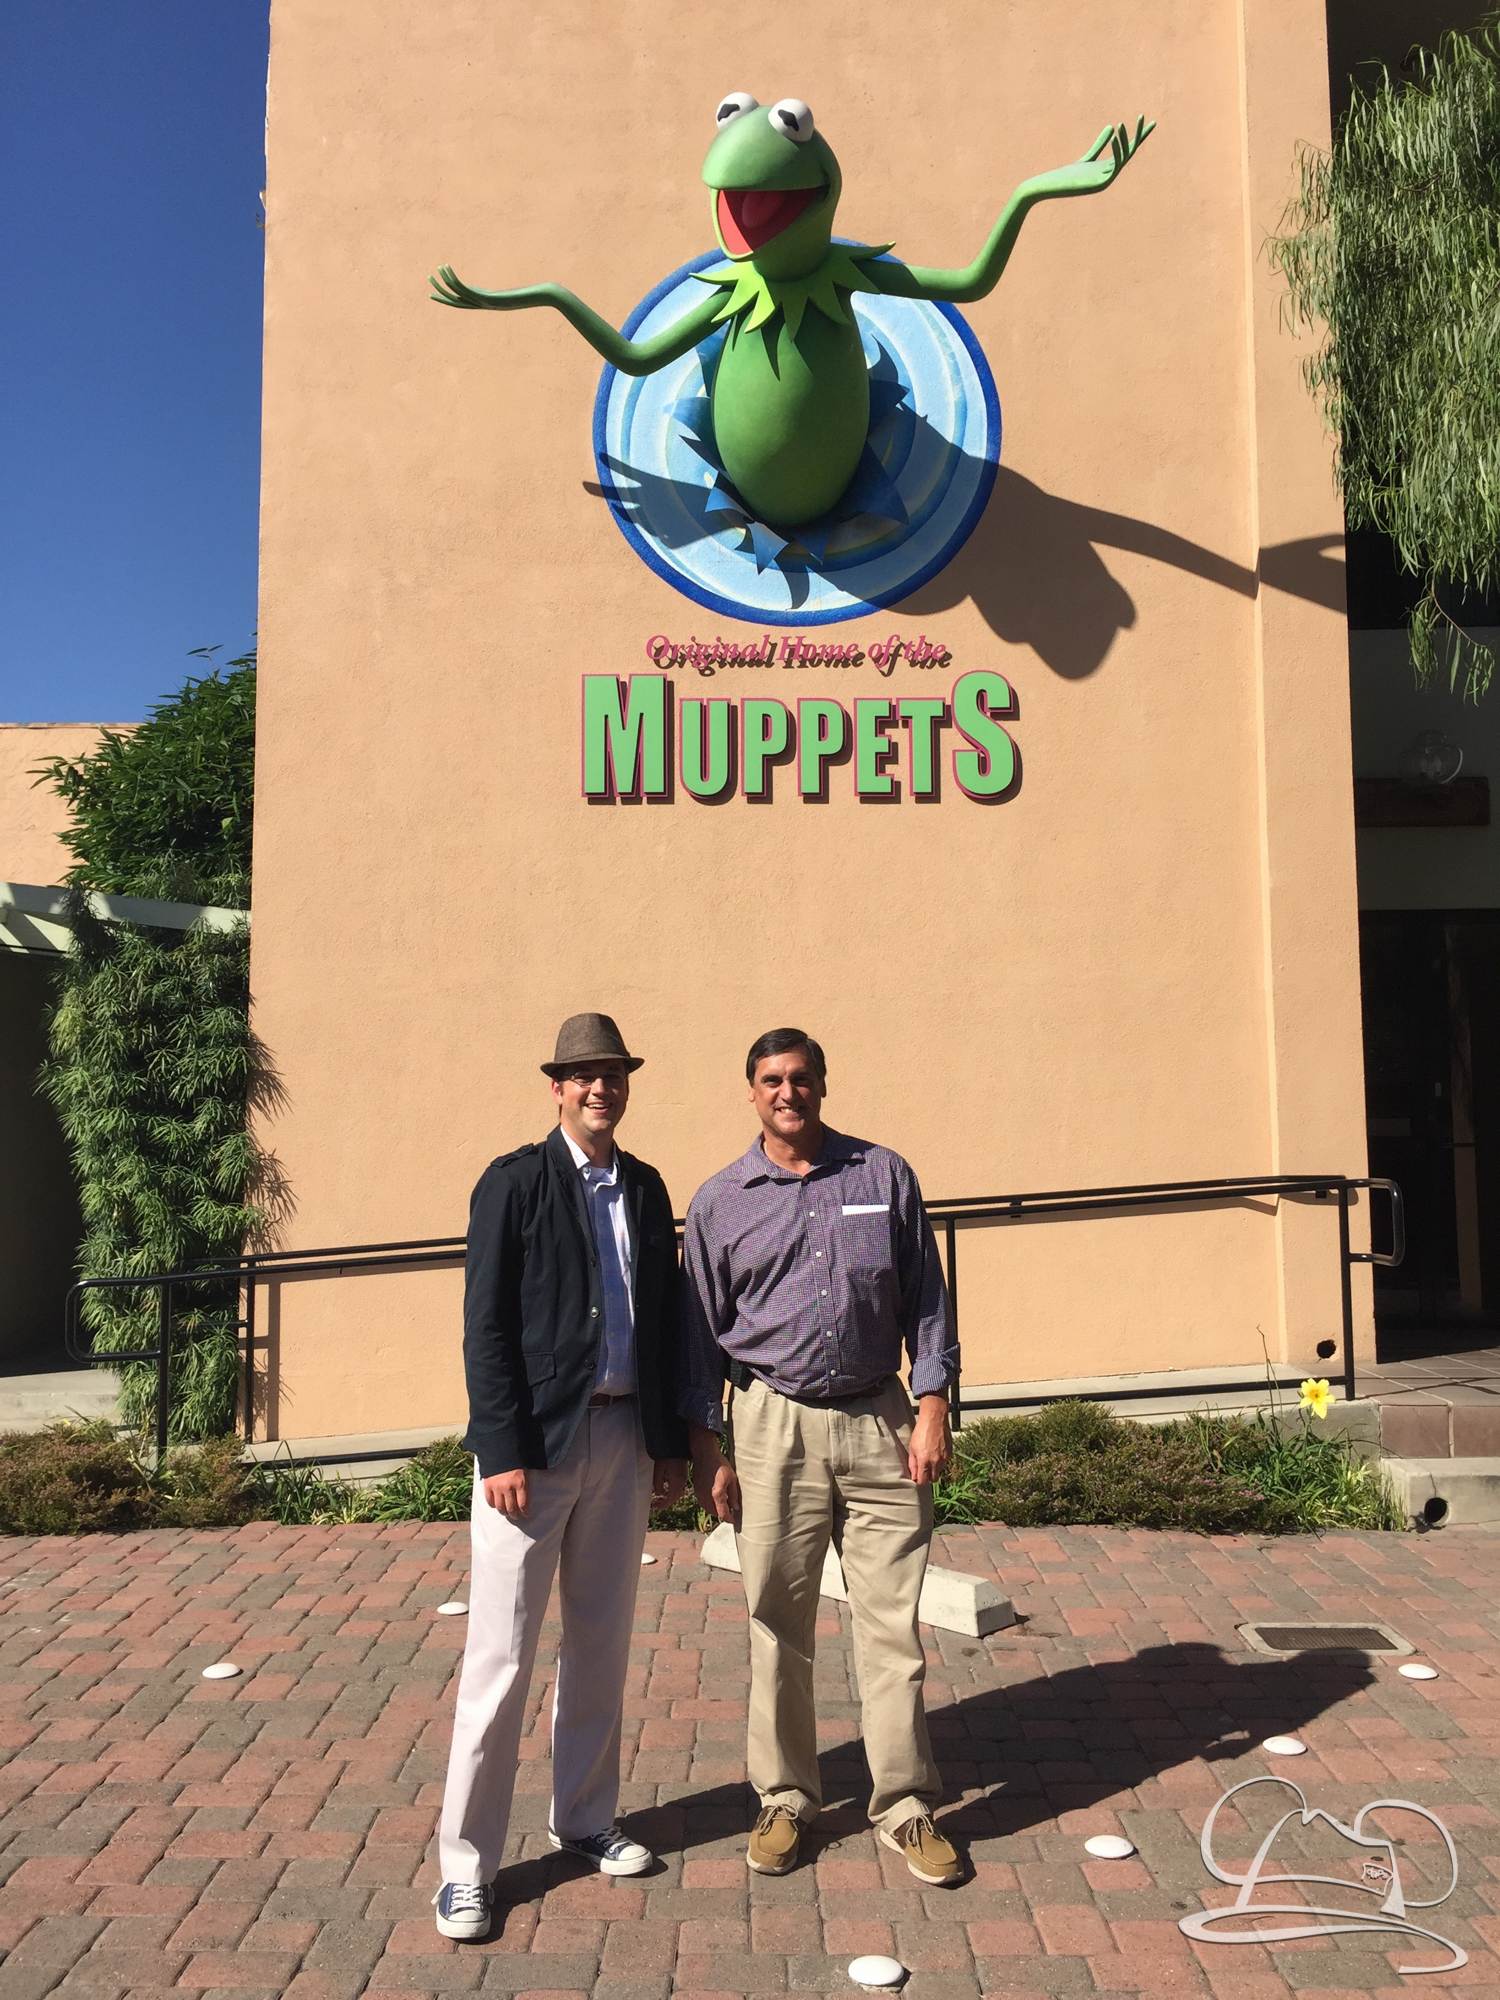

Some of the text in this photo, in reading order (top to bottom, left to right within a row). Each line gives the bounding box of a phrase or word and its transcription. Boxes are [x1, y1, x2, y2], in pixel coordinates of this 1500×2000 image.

[646, 634, 947, 669] Original Home of the
[581, 670, 1016, 799] MUPPETS
